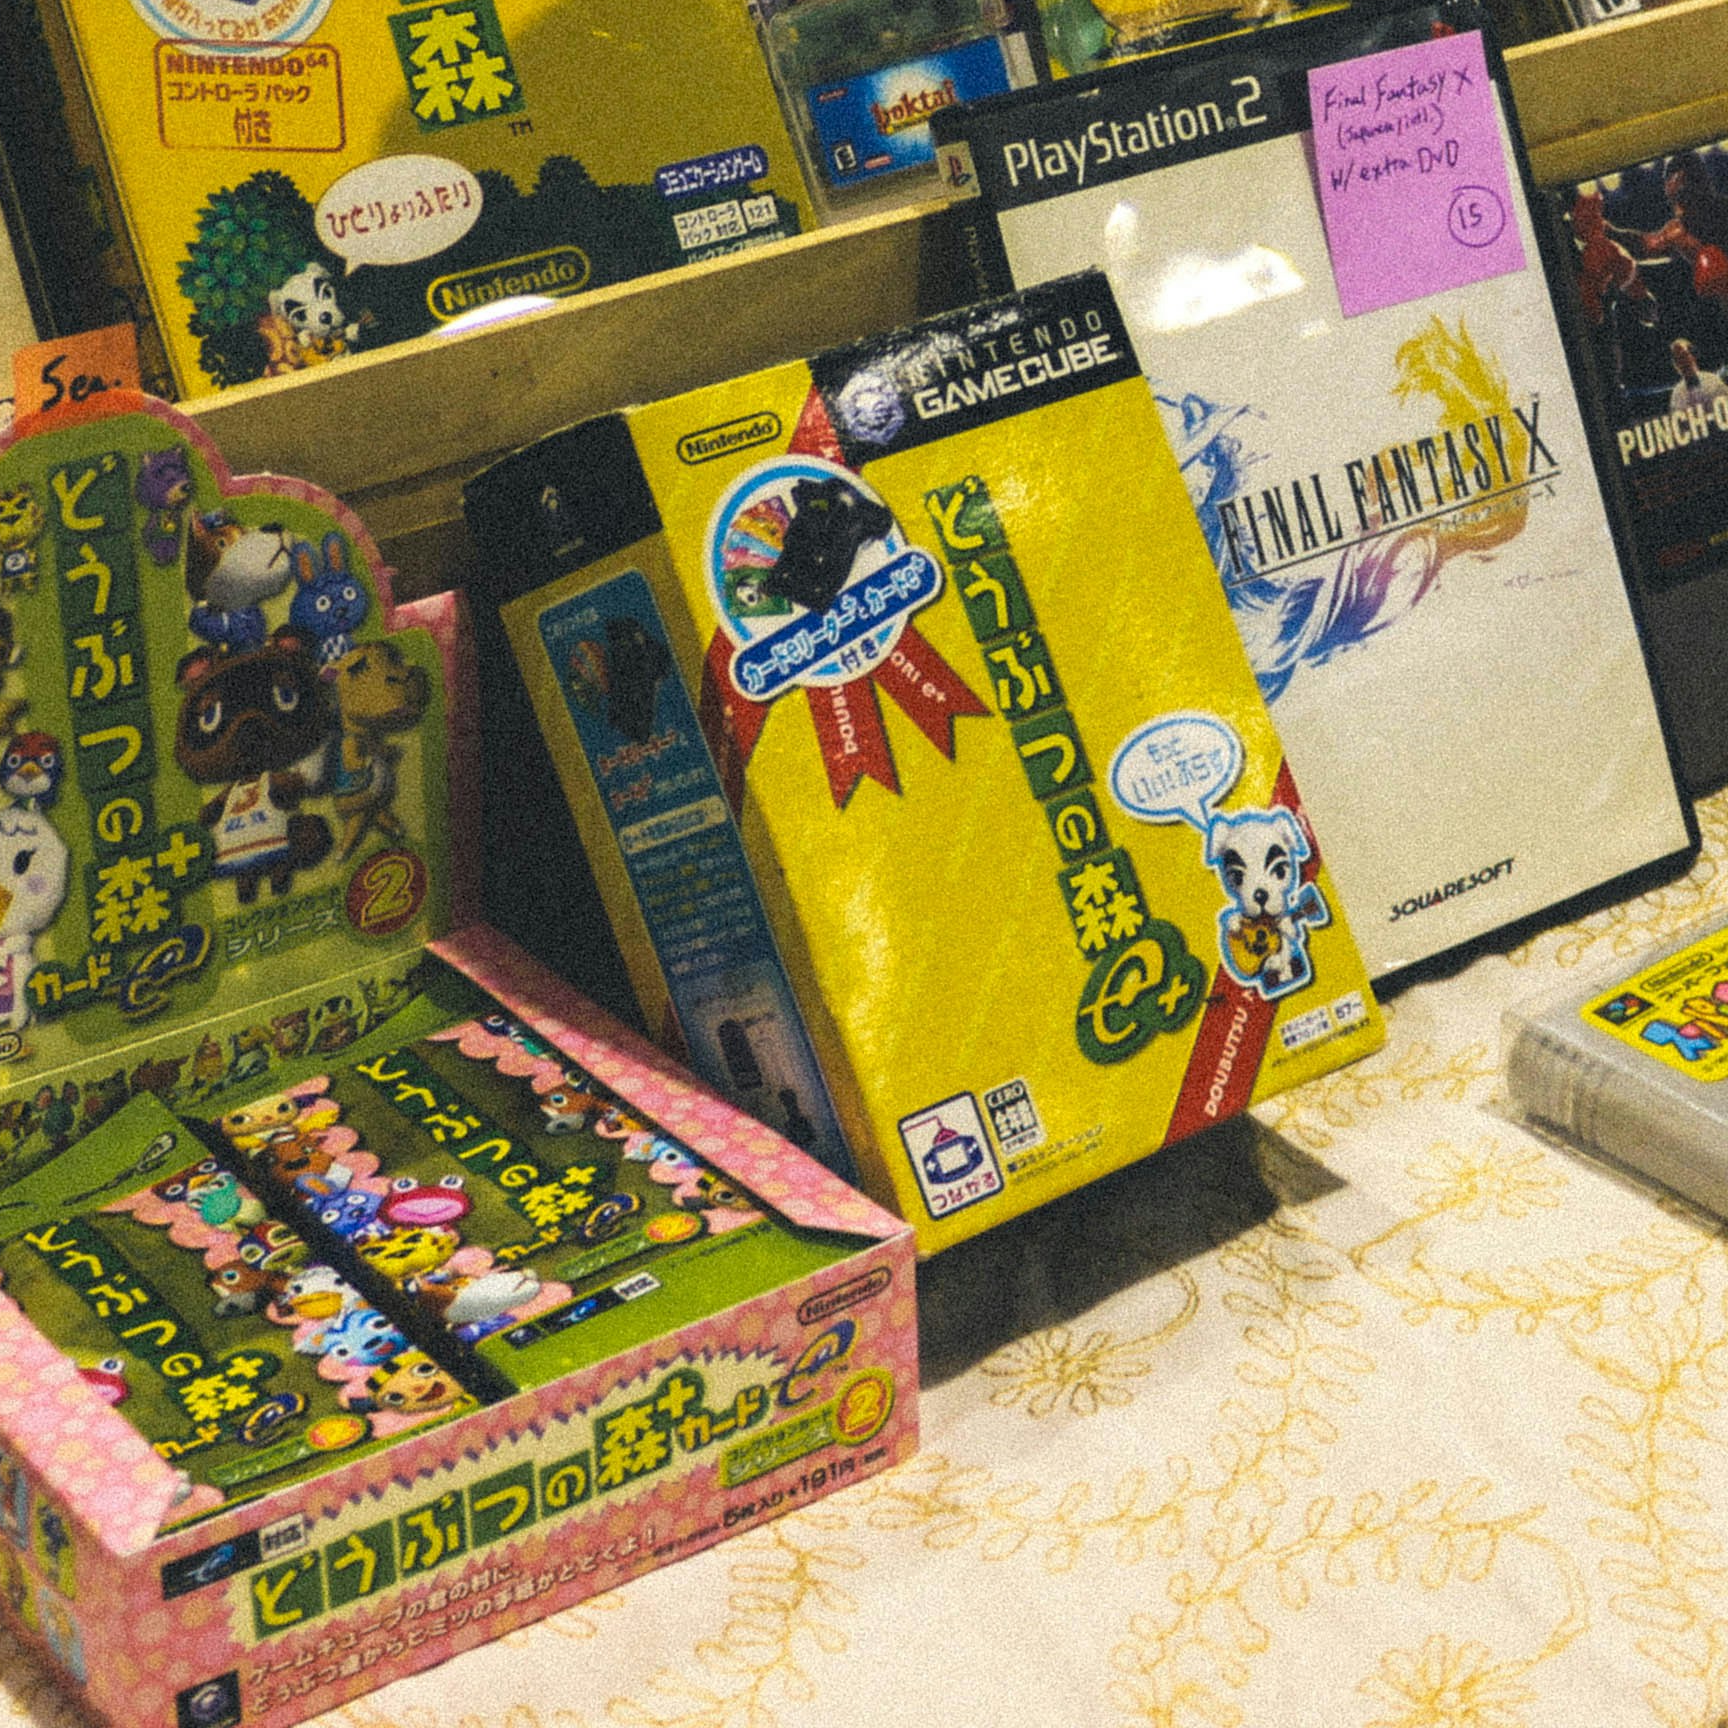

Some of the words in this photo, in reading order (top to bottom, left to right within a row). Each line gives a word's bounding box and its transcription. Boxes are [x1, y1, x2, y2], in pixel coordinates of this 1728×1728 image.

[165, 54, 305, 78] NINTENDO
[264, 81, 312, 105] パック
[1322, 85, 1367, 123] Final
[1373, 70, 1445, 113] Fantasy
[1452, 65, 1474, 95] X
[233, 107, 273, 145] 付き
[1004, 104, 1227, 188] PlayStation
[1230, 75, 1267, 127] 2
[1358, 155, 1410, 185] extra
[1416, 139, 1461, 176] DVD
[1456, 202, 1484, 231] 15
[439, 259, 578, 313] Nintendo
[913, 333, 1118, 421] GAMECUBE
[684, 418, 775, 459] Nintendo
[1217, 472, 1345, 575] FINAL
[1344, 412, 1513, 532] FANTASY
[1513, 398, 1559, 475] X
[839, 637, 878, 672] 付き
[926, 475, 1146, 952] どうぶつの森
[359, 856, 413, 928] 2
[1389, 857, 1516, 923] SQUARESOFT
[26, 952, 118, 1007] カード
[1204, 1008, 1250, 1118] DOUBUTSU
[805, 1269, 886, 1320] Nintendo
[677, 1384, 763, 1452] カード
[843, 1374, 880, 1432] 2
